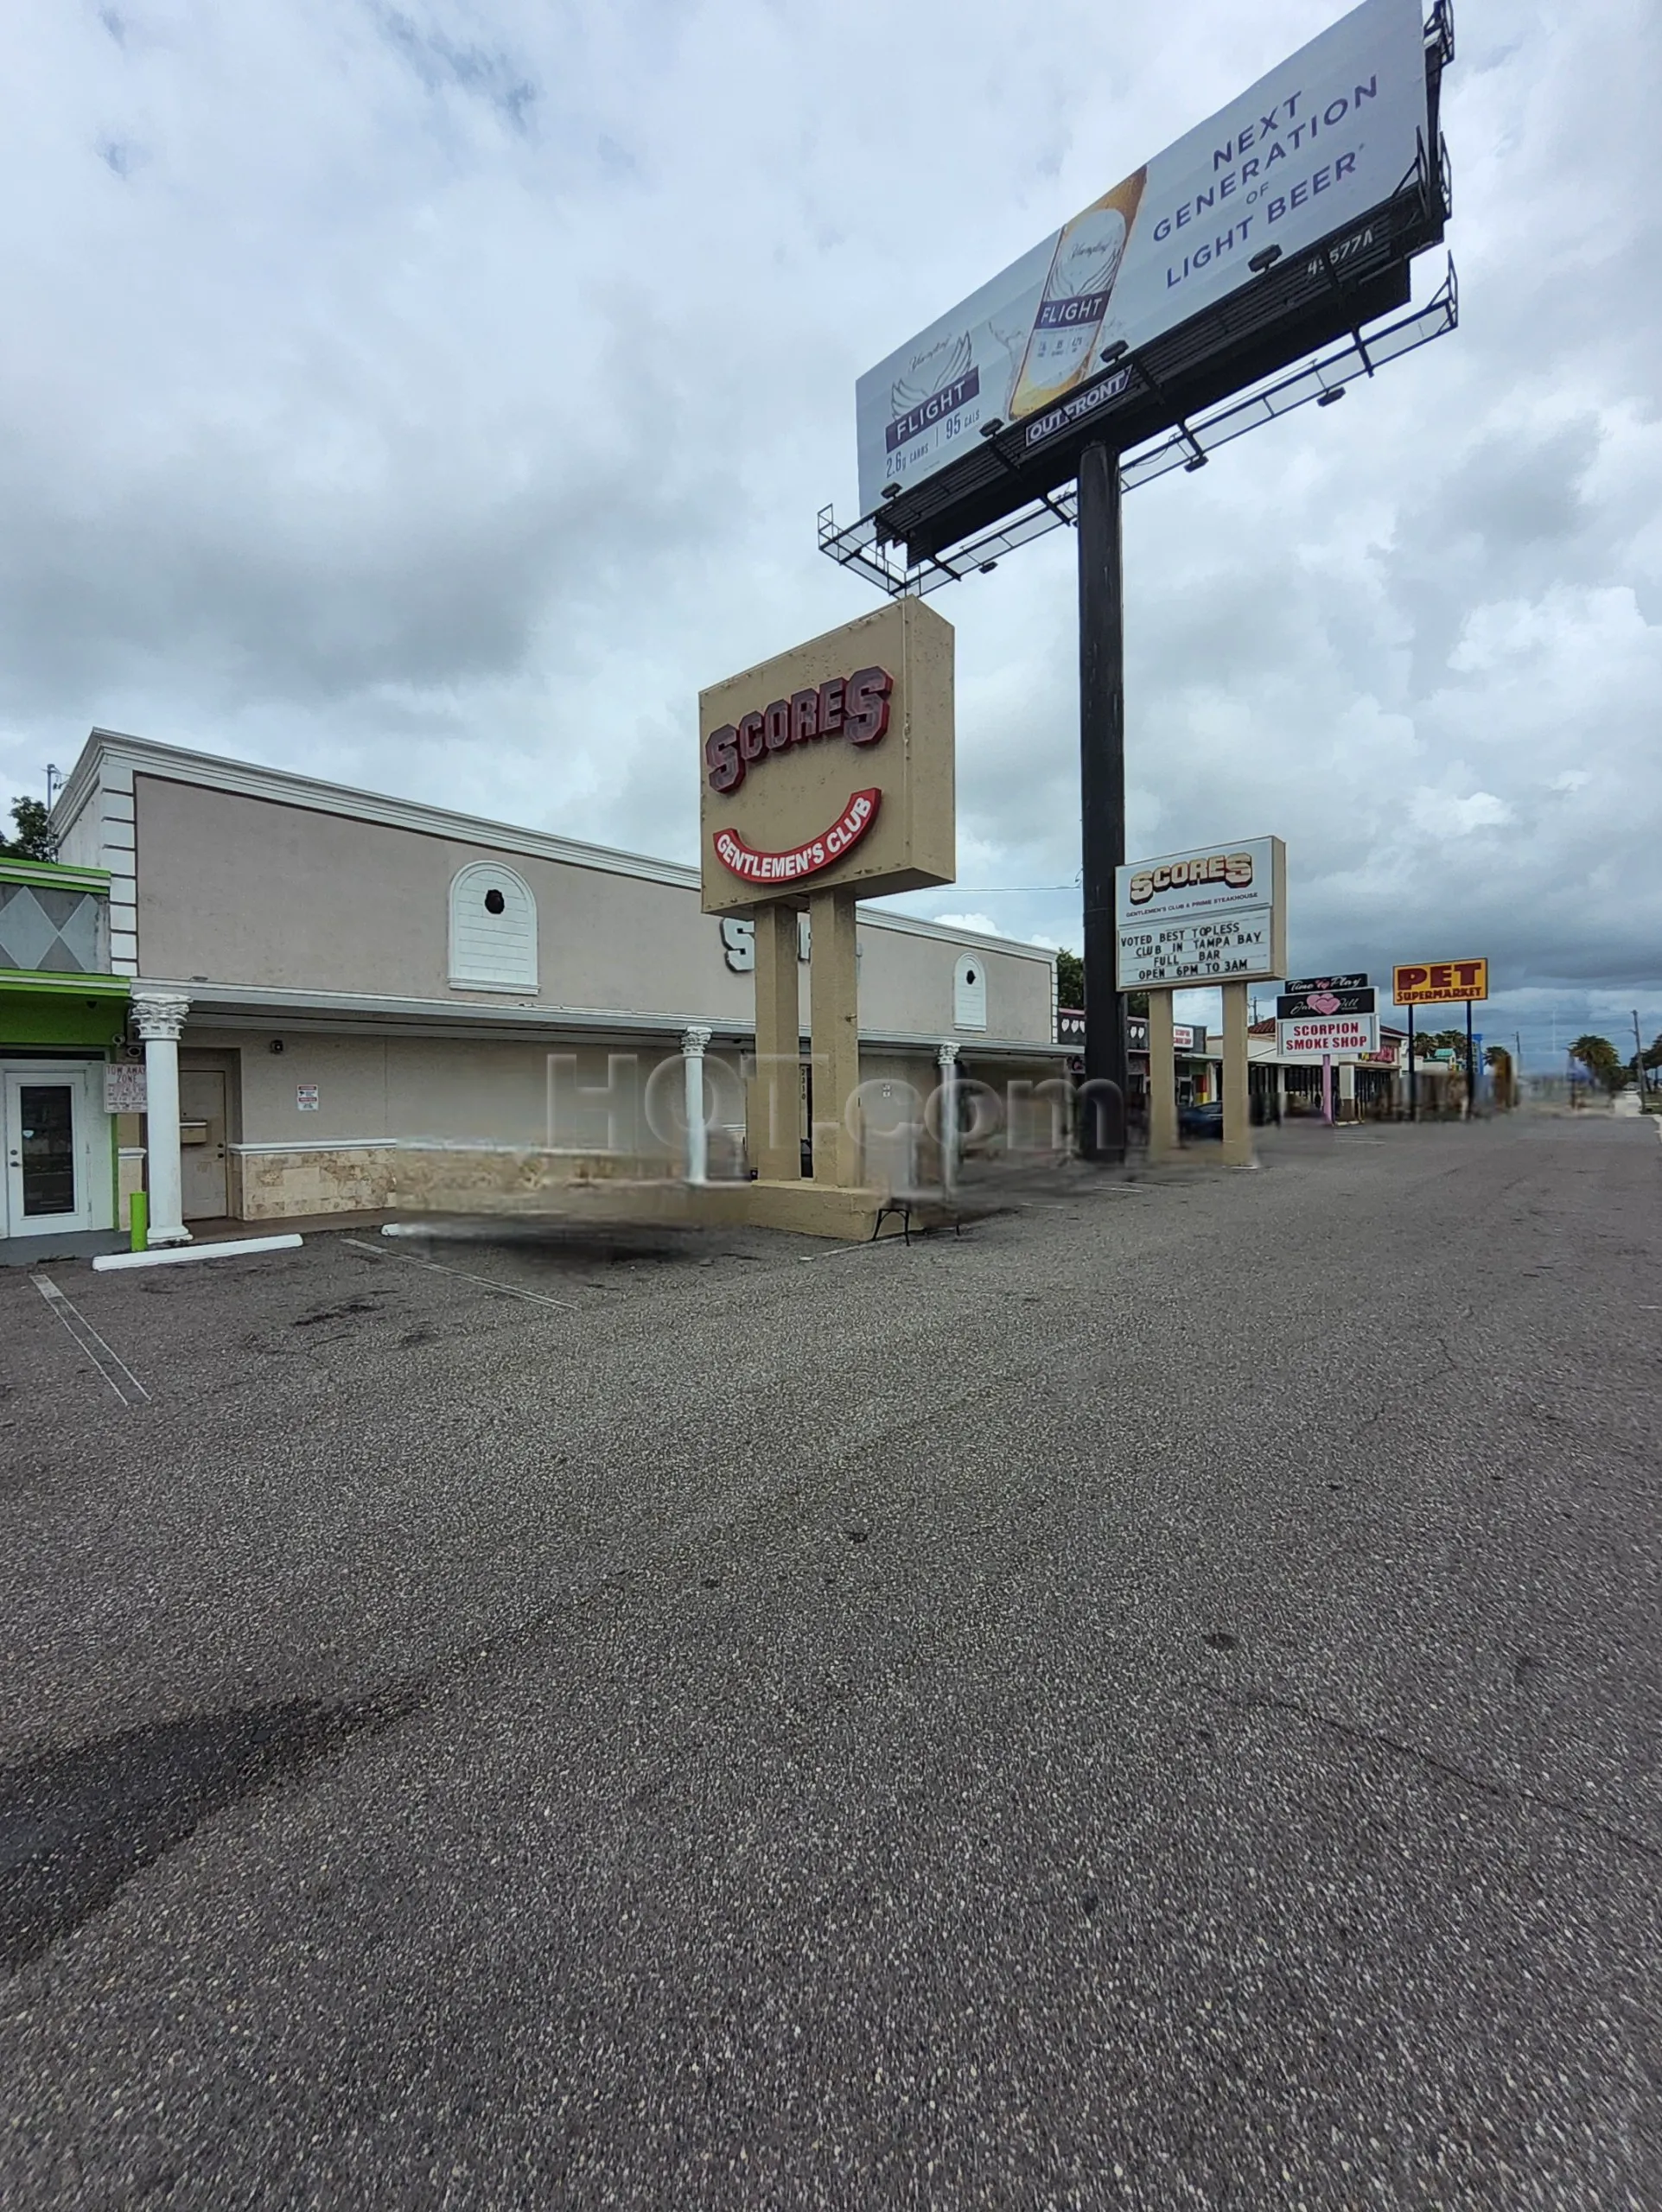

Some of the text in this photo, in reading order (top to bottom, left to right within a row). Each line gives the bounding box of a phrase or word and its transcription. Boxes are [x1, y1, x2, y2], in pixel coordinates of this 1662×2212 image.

[1213, 90, 1302, 172] NEXT
[1153, 74, 1378, 242] GENERATION
[1246, 181, 1269, 205] OF
[1167, 215, 1253, 289] LIGHT
[1041, 297, 1103, 324] FLIGHT
[897, 380, 965, 442] FLIGHT
[946, 411, 961, 440] 95
[965, 409, 980, 428] CALS
[704, 664, 894, 794] SCORES
[716, 797, 871, 878] GENTLEMEN'S CLUB
[1130, 852, 1253, 906] SCORES
[1125, 906, 1167, 918] GENTLEMEN'S
[1213, 892, 1258, 904] STEAKHOUSE
[1121, 922, 1239, 947] VOTED BEST TOPLESS
[1136, 931, 1262, 957] CLUB IN TAMPA BAY
[1138, 959, 1247, 980] OPEN 6PM TO 3AM
[1154, 950, 1220, 967] FULL BAR
[1288, 980, 1314, 991] Time
[1330, 976, 1362, 988] Play
[1397, 962, 1481, 990] PET
[1397, 986, 1482, 1001] SUPERMARKET
[1293, 1022, 1359, 1037] SCORPION
[1286, 1035, 1367, 1051] SMOKE SHOP
[117, 1074, 137, 1084] ZONE
